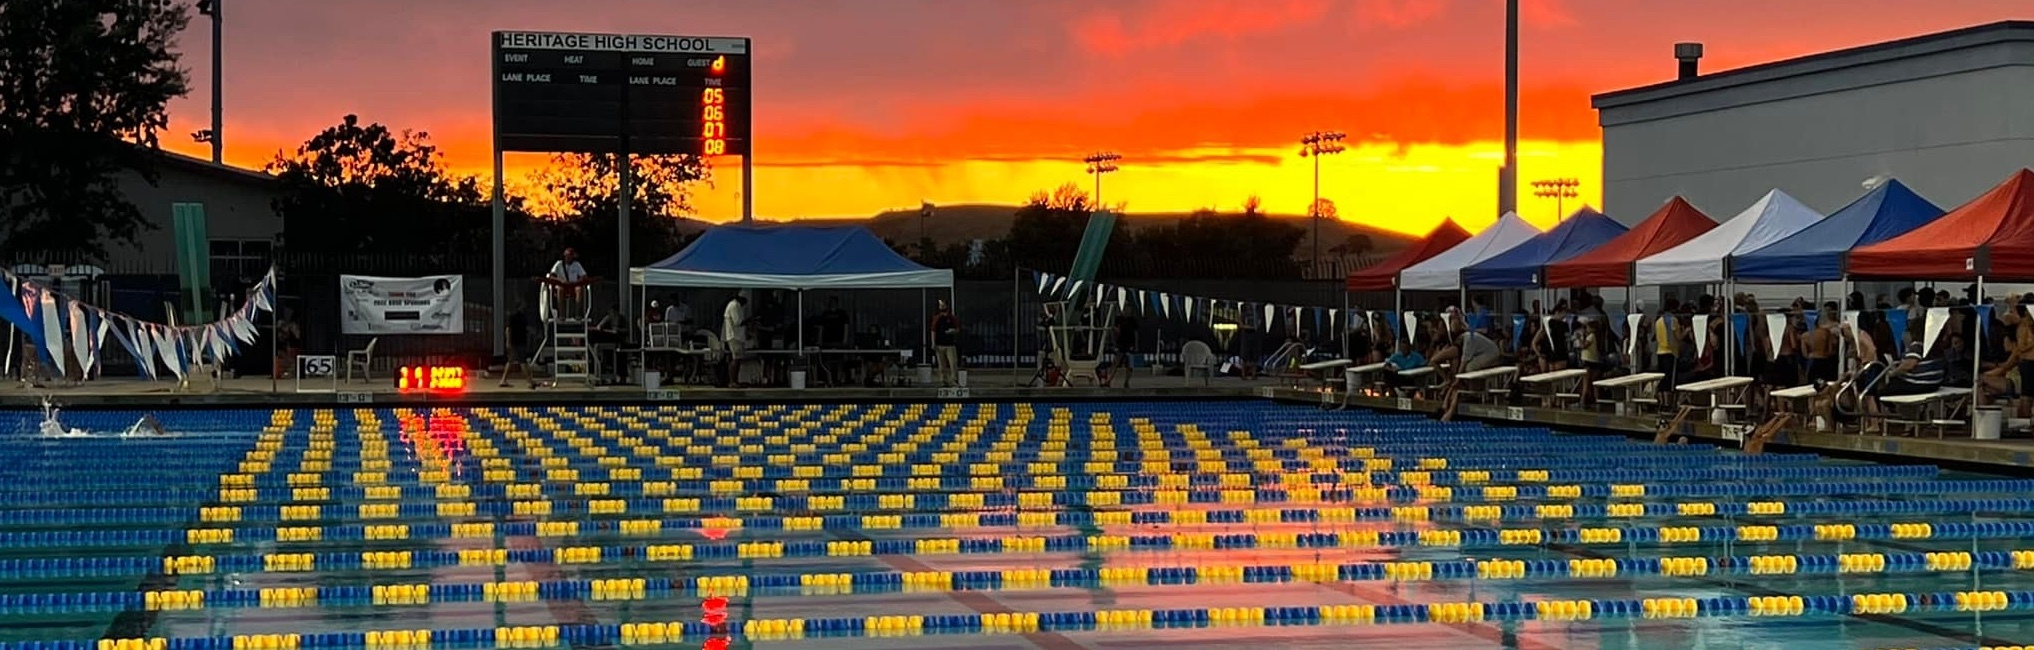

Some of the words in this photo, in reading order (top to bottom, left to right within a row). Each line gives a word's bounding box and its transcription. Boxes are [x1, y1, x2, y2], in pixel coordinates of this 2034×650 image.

[501, 33, 589, 48] HERITAGE
[595, 35, 637, 50] HIGH
[642, 37, 715, 51] SCHOOL
[504, 54, 528, 62] EVENT
[564, 55, 584, 64] HEAT
[632, 57, 654, 66] HOME
[687, 58, 711, 67] GUEST
[502, 73, 523, 82] LANE
[527, 74, 551, 82] PLACE
[579, 75, 598, 84] TIME
[629, 76, 649, 85] LANE
[653, 77, 677, 85] PLACE
[704, 78, 722, 86] TIME
[704, 88, 724, 104] 05
[704, 105, 724, 121] 06
[704, 122, 724, 138] 07
[705, 139, 725, 155] 08
[307, 358, 332, 374] 65
